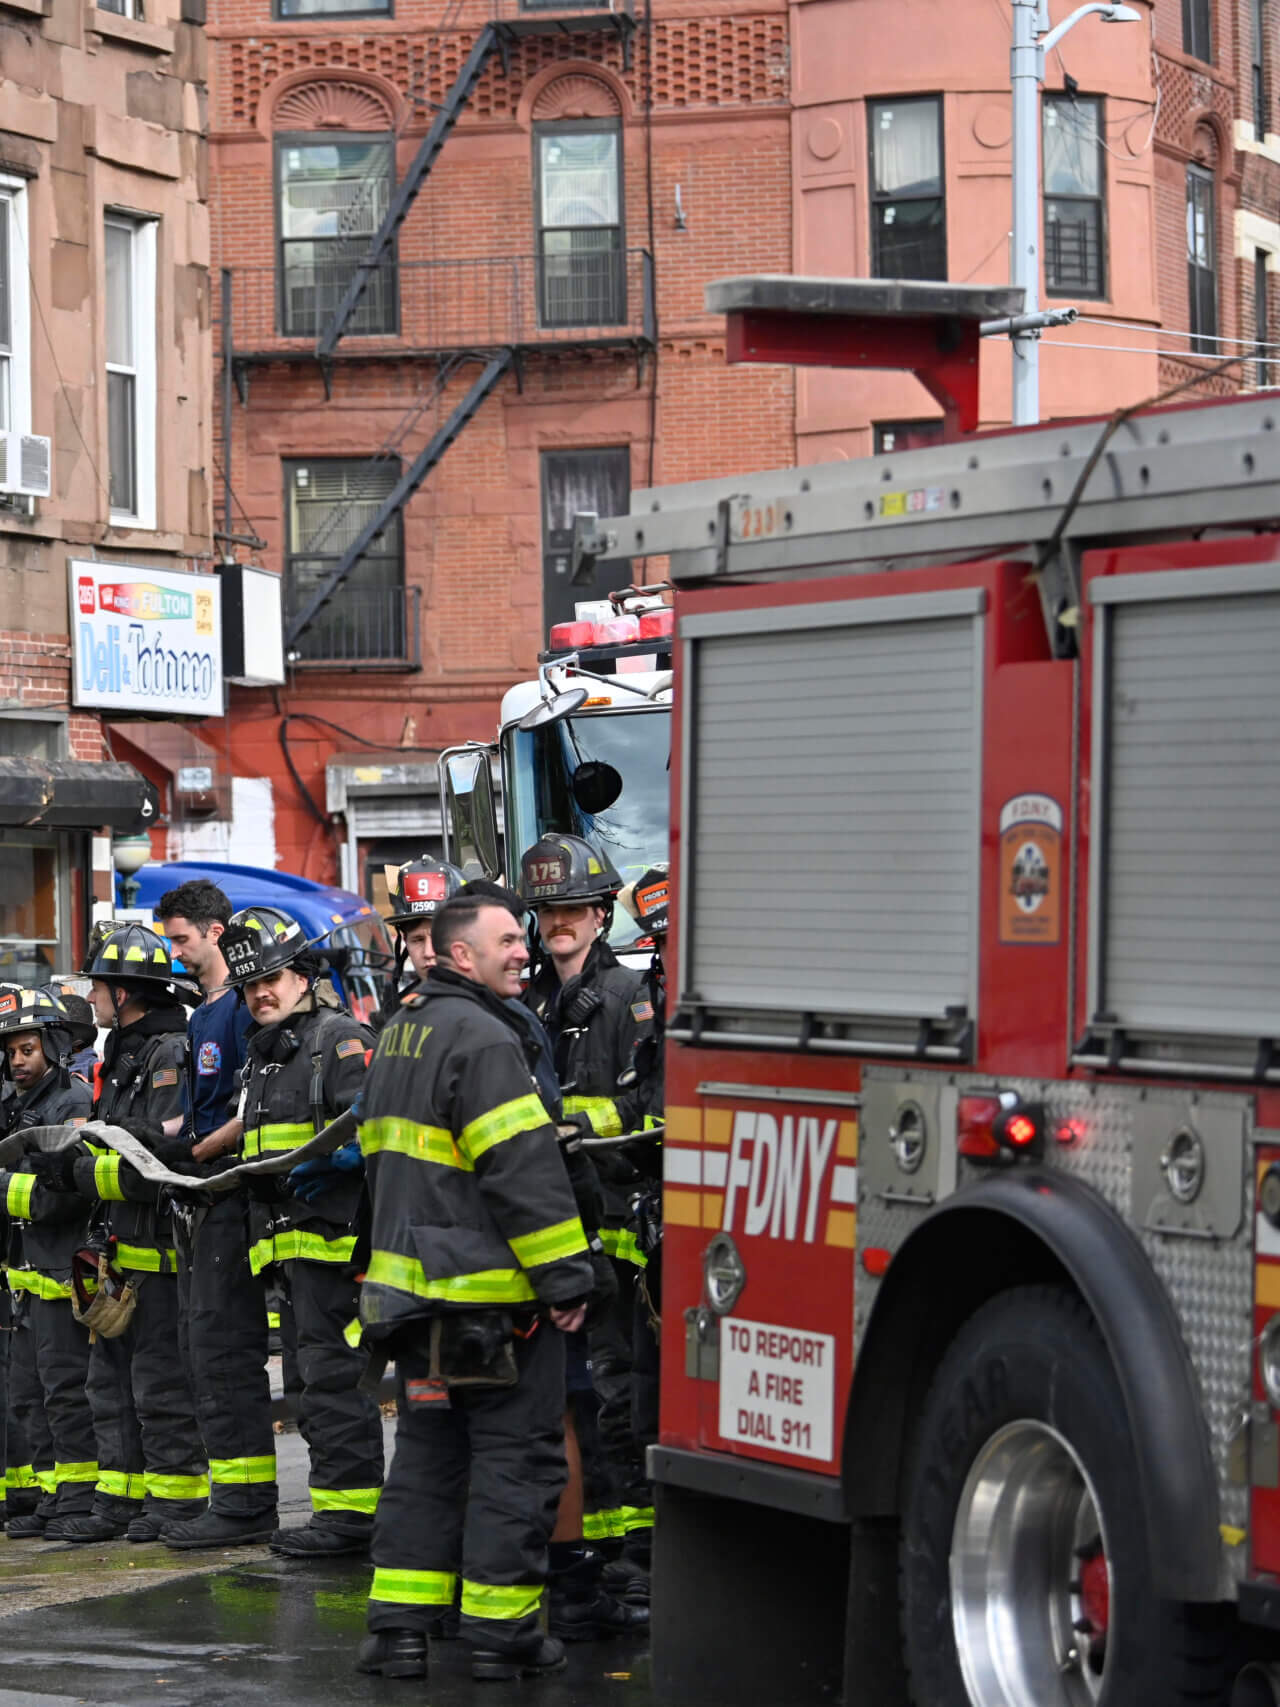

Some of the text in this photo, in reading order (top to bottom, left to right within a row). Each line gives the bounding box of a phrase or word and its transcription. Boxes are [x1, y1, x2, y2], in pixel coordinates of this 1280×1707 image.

[143, 591, 190, 616] FULTON
[80, 622, 120, 692] Deli
[128, 624, 212, 699] Tobacco
[418, 878, 429, 896] 9
[530, 861, 561, 882] 175
[411, 900, 435, 913] 12590
[226, 940, 255, 962] 231
[723, 1111, 837, 1243] FDNY
[729, 1325, 825, 1368] TO REPORT
[748, 1369, 803, 1406] A FIRE
[738, 1408, 811, 1450] DIAL 911
